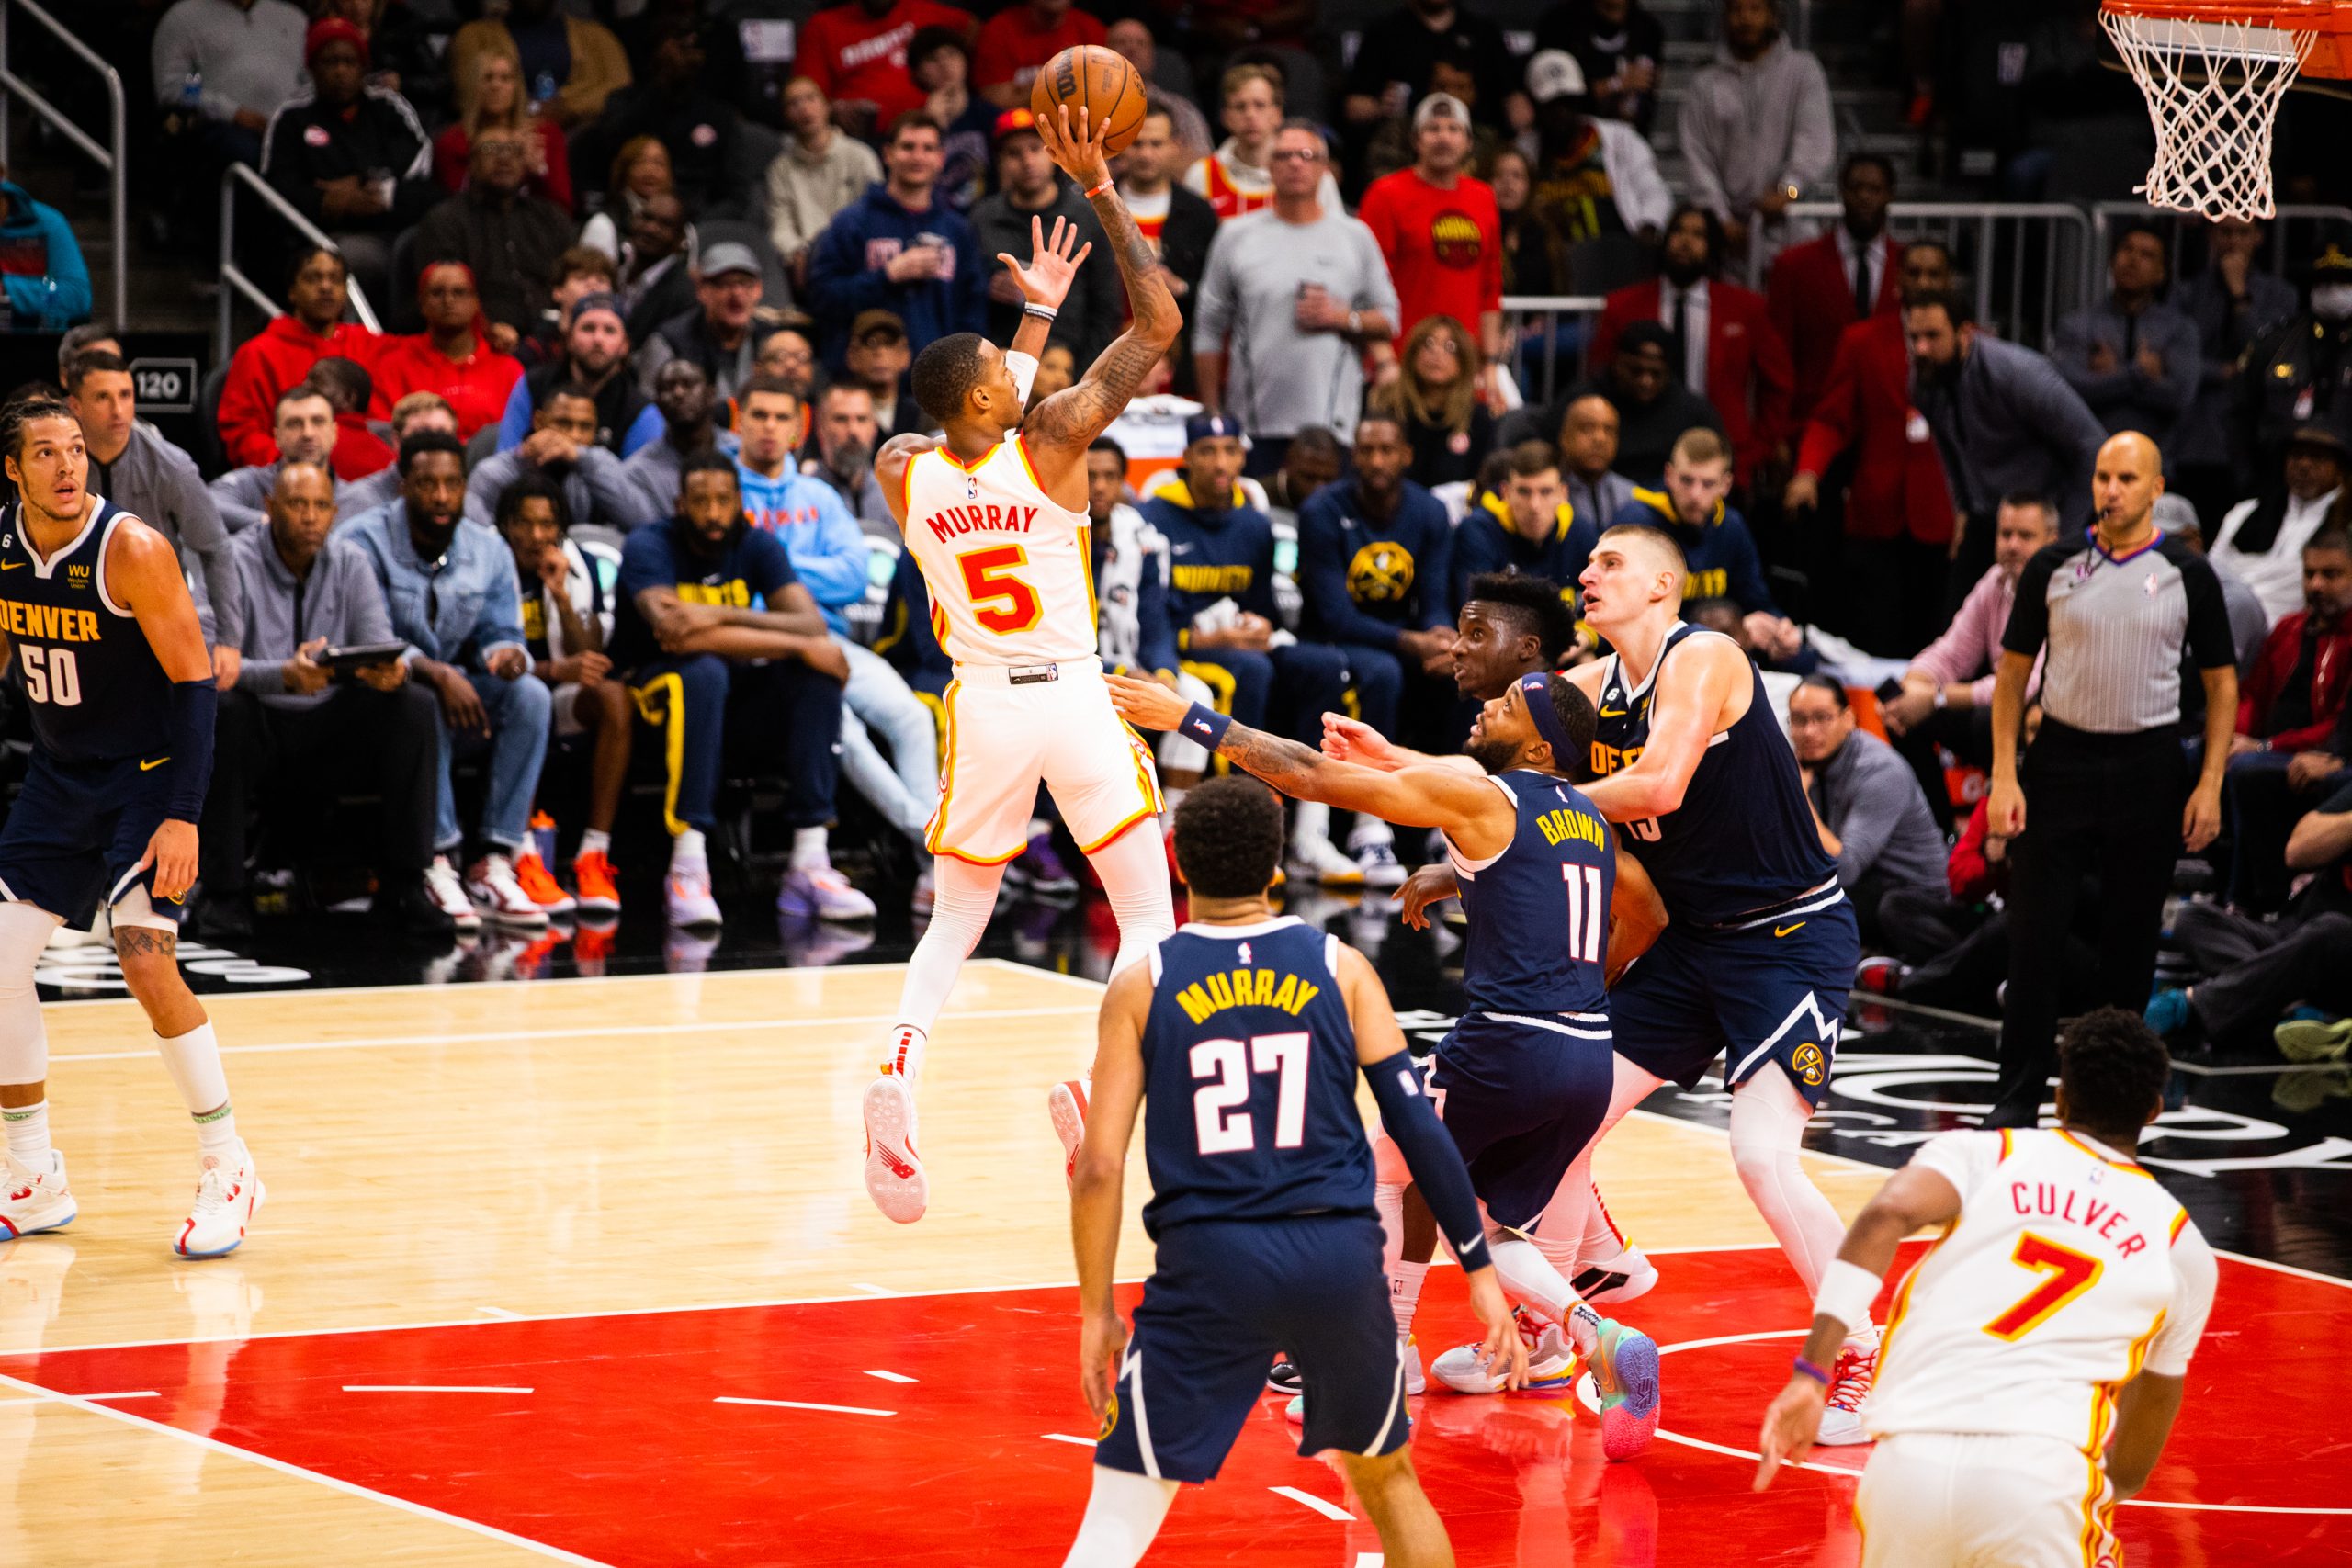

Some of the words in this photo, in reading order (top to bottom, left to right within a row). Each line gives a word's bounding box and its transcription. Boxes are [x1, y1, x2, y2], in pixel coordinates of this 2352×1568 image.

[136, 371, 182, 399] 120
[2, 534, 12, 548] 6
[926, 505, 1038, 544] MURRAY
[68, 564, 90, 577] WU
[956, 543, 1044, 637] 5
[0, 599, 101, 641] DENVER
[19, 643, 82, 706] 50
[1606, 688, 1620, 701] 6
[1536, 809, 1604, 852] BROWN
[1562, 862, 1601, 964] 11
[1176, 969, 1319, 1025] MURRAY
[1189, 1031, 1311, 1156] 27
[2011, 1181, 2146, 1260] CULVER
[1981, 1230, 2104, 1342] 7
